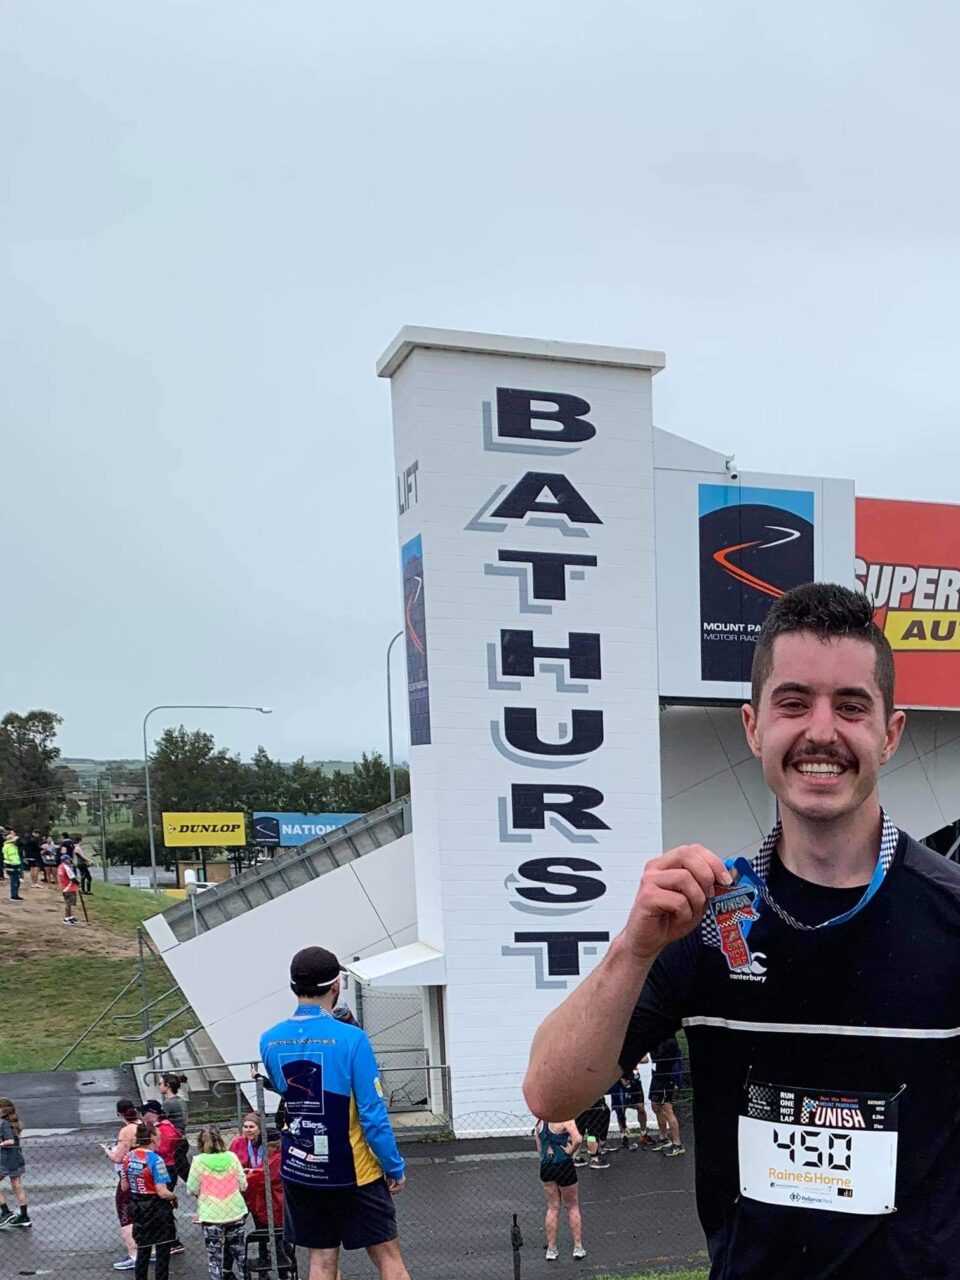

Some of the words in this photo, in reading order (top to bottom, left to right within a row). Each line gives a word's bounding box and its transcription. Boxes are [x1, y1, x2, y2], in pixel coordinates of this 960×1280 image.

[398, 460, 419, 516] LIFT
[703, 622, 745, 632] MOUNT
[703, 633, 738, 641] MOTOR
[490, 387, 612, 976] BATHURST
[178, 824, 241, 833] DUNLOP
[281, 823, 343, 835] NATION
[729, 973, 767, 983] canterbury
[780, 1091, 795, 1100] RUN
[780, 1107, 795, 1115] HOT
[773, 1128, 852, 1171] 450
[768, 1167, 851, 1188] Raine&Horne
